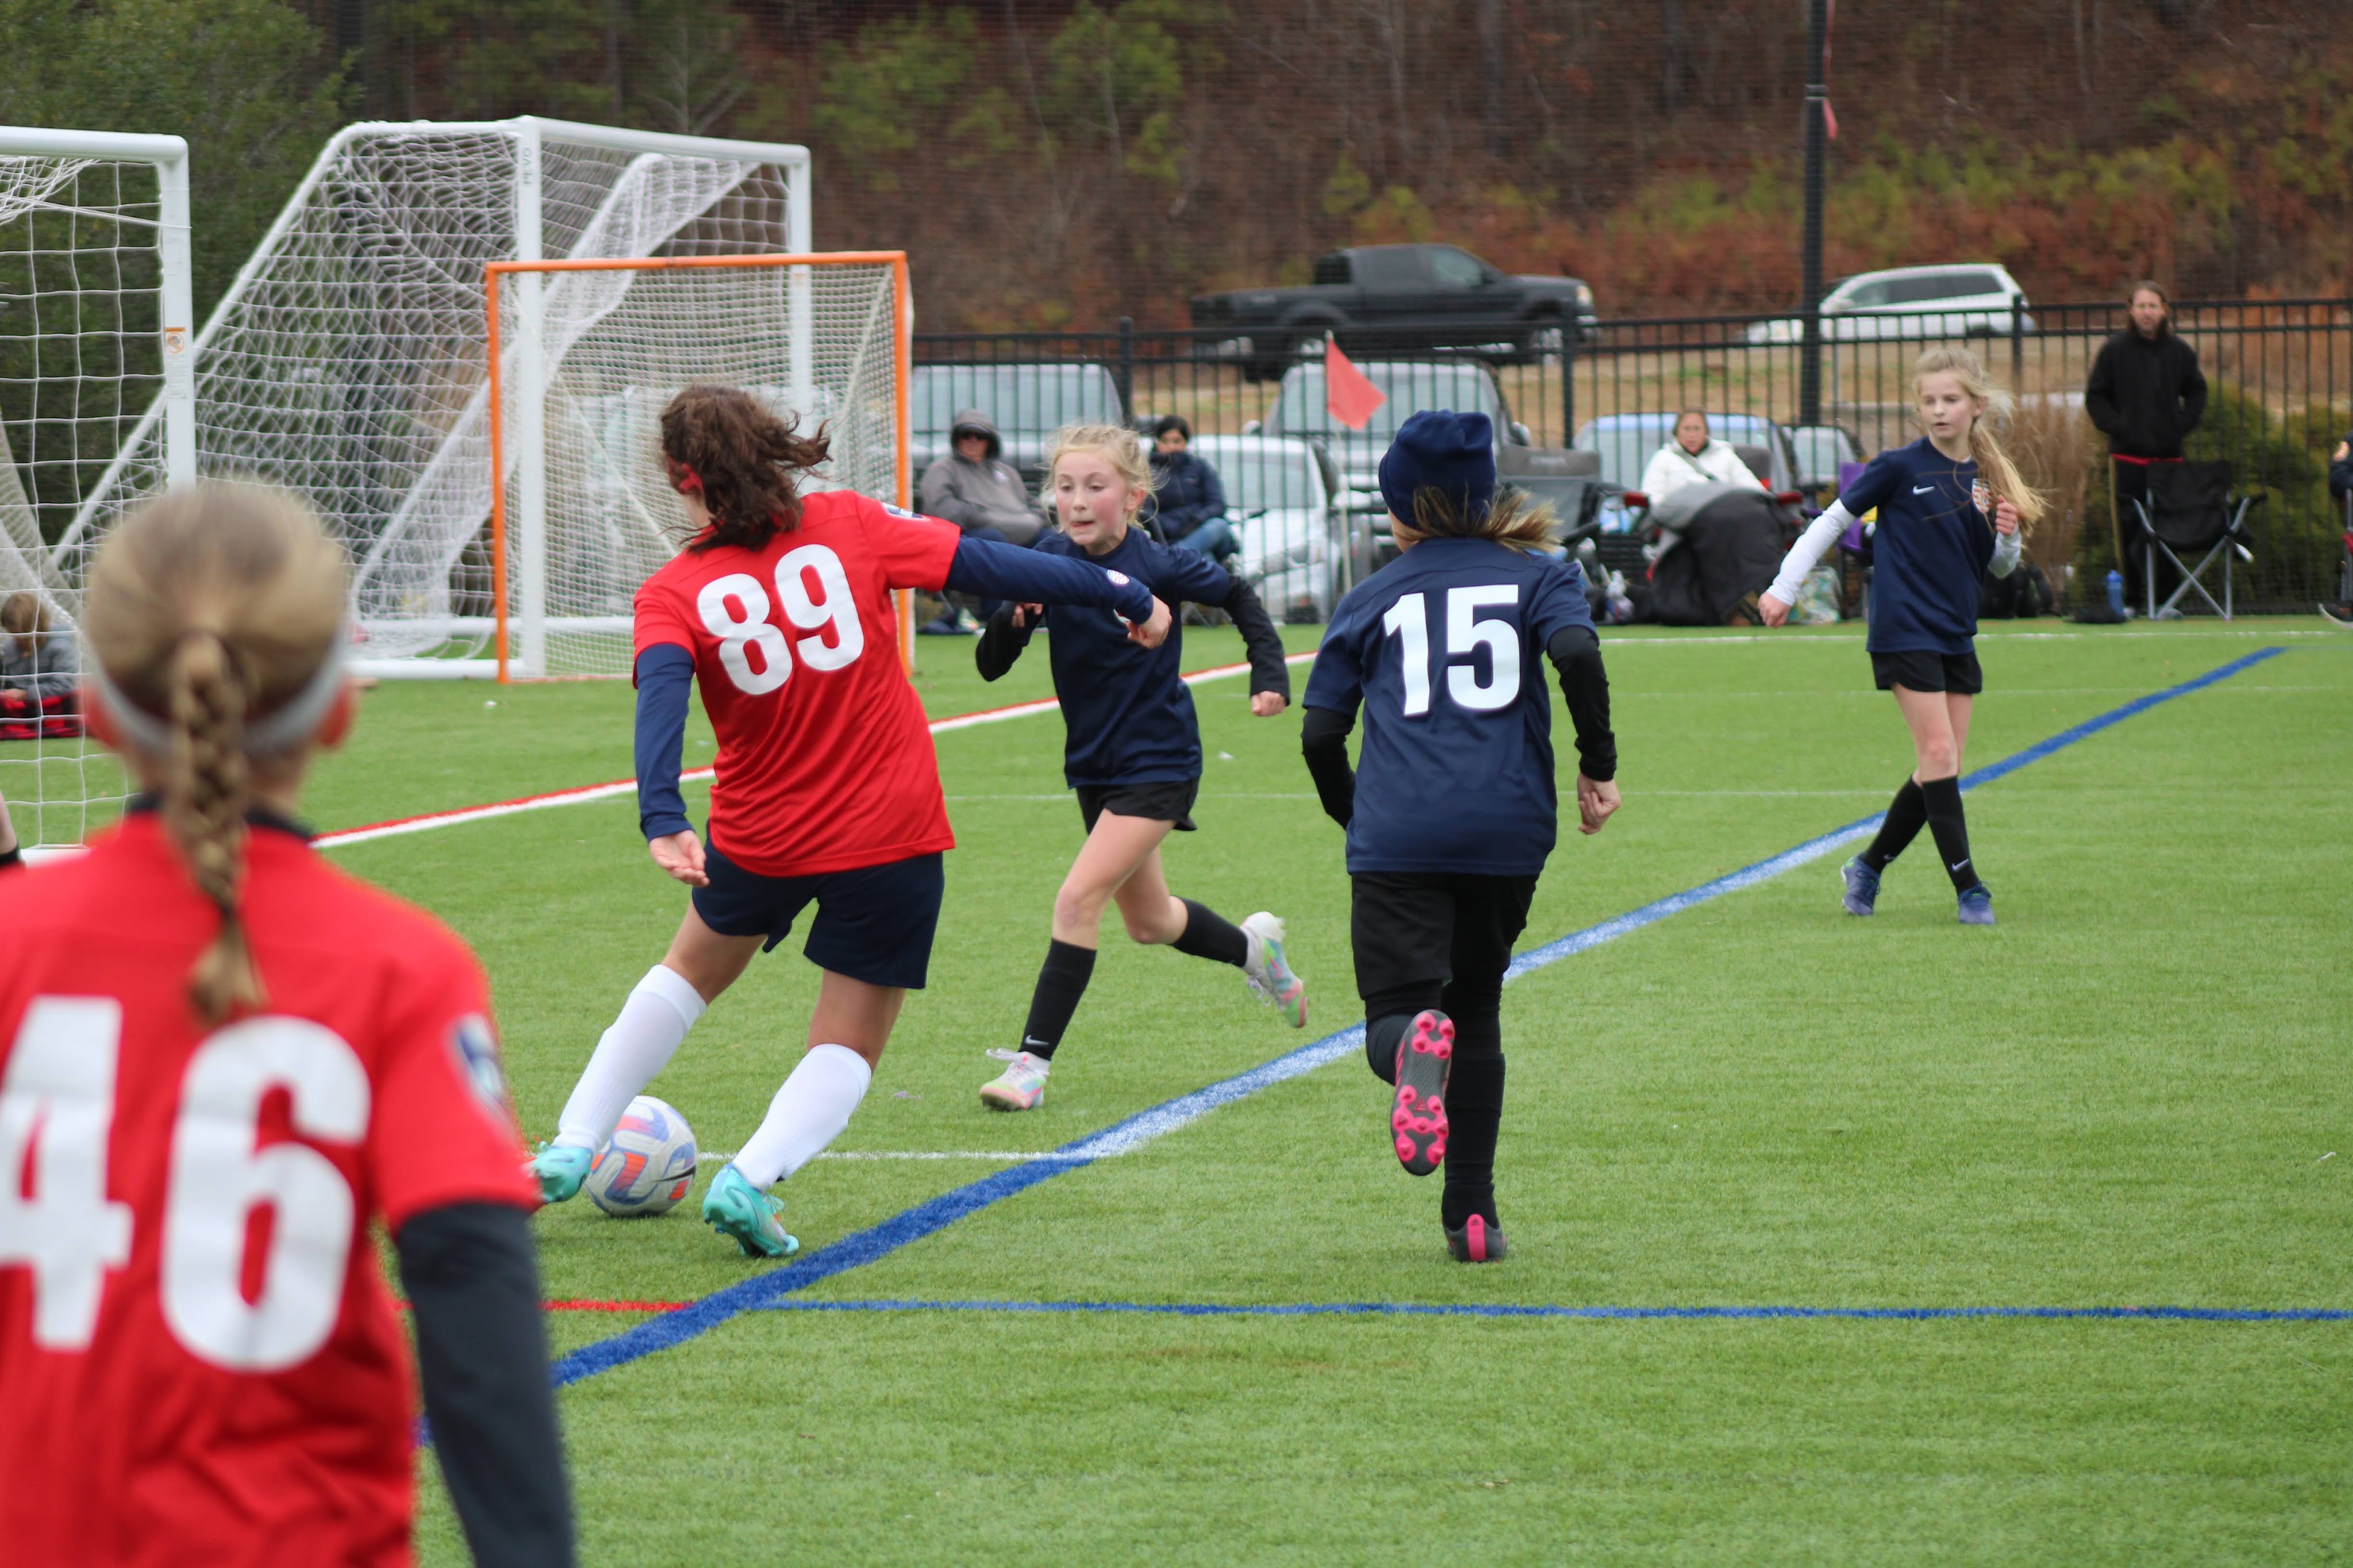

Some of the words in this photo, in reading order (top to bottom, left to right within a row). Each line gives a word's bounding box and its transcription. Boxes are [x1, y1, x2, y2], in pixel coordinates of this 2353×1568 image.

[696, 543, 865, 695] 89
[1383, 584, 1521, 716] 15
[0, 995, 371, 1370] 46
